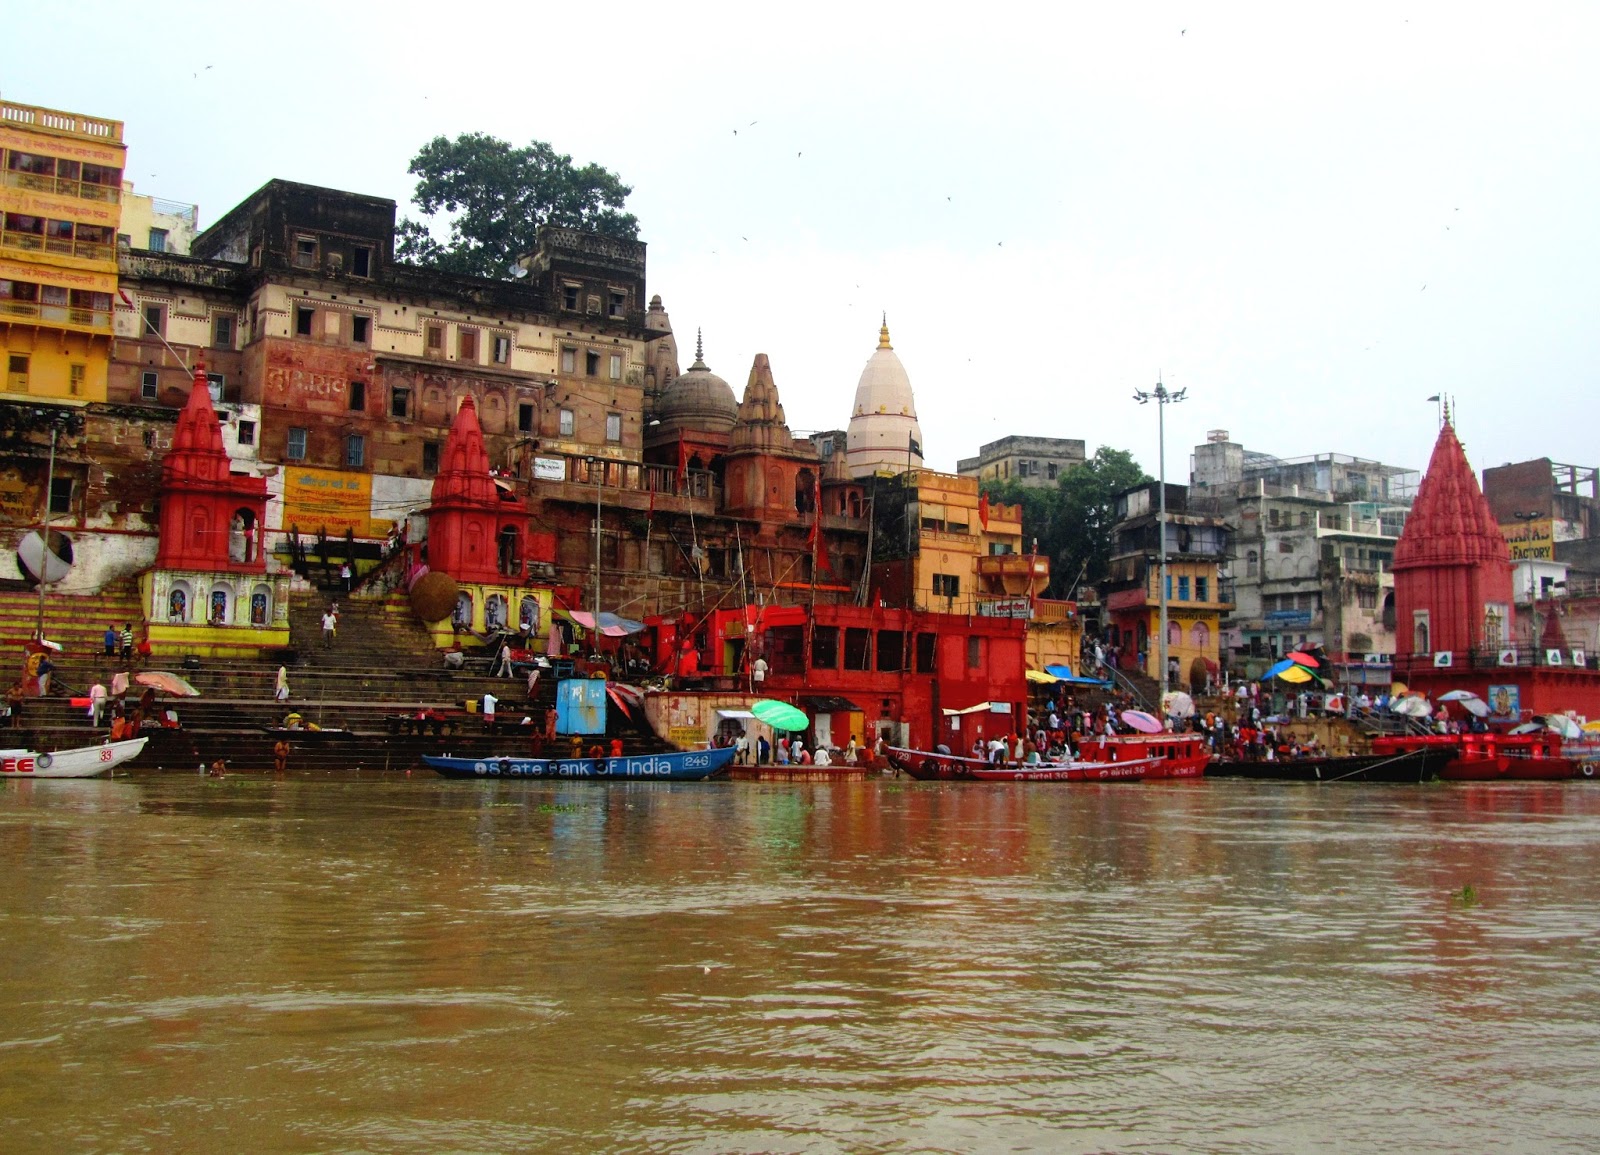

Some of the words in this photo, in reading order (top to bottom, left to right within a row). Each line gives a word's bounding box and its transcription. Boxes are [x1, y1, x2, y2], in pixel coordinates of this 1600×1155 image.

[100, 750, 111, 761] 33
[489, 762, 543, 777] State
[626, 757, 672, 776] India
[1110, 767, 1133, 777] airtel
